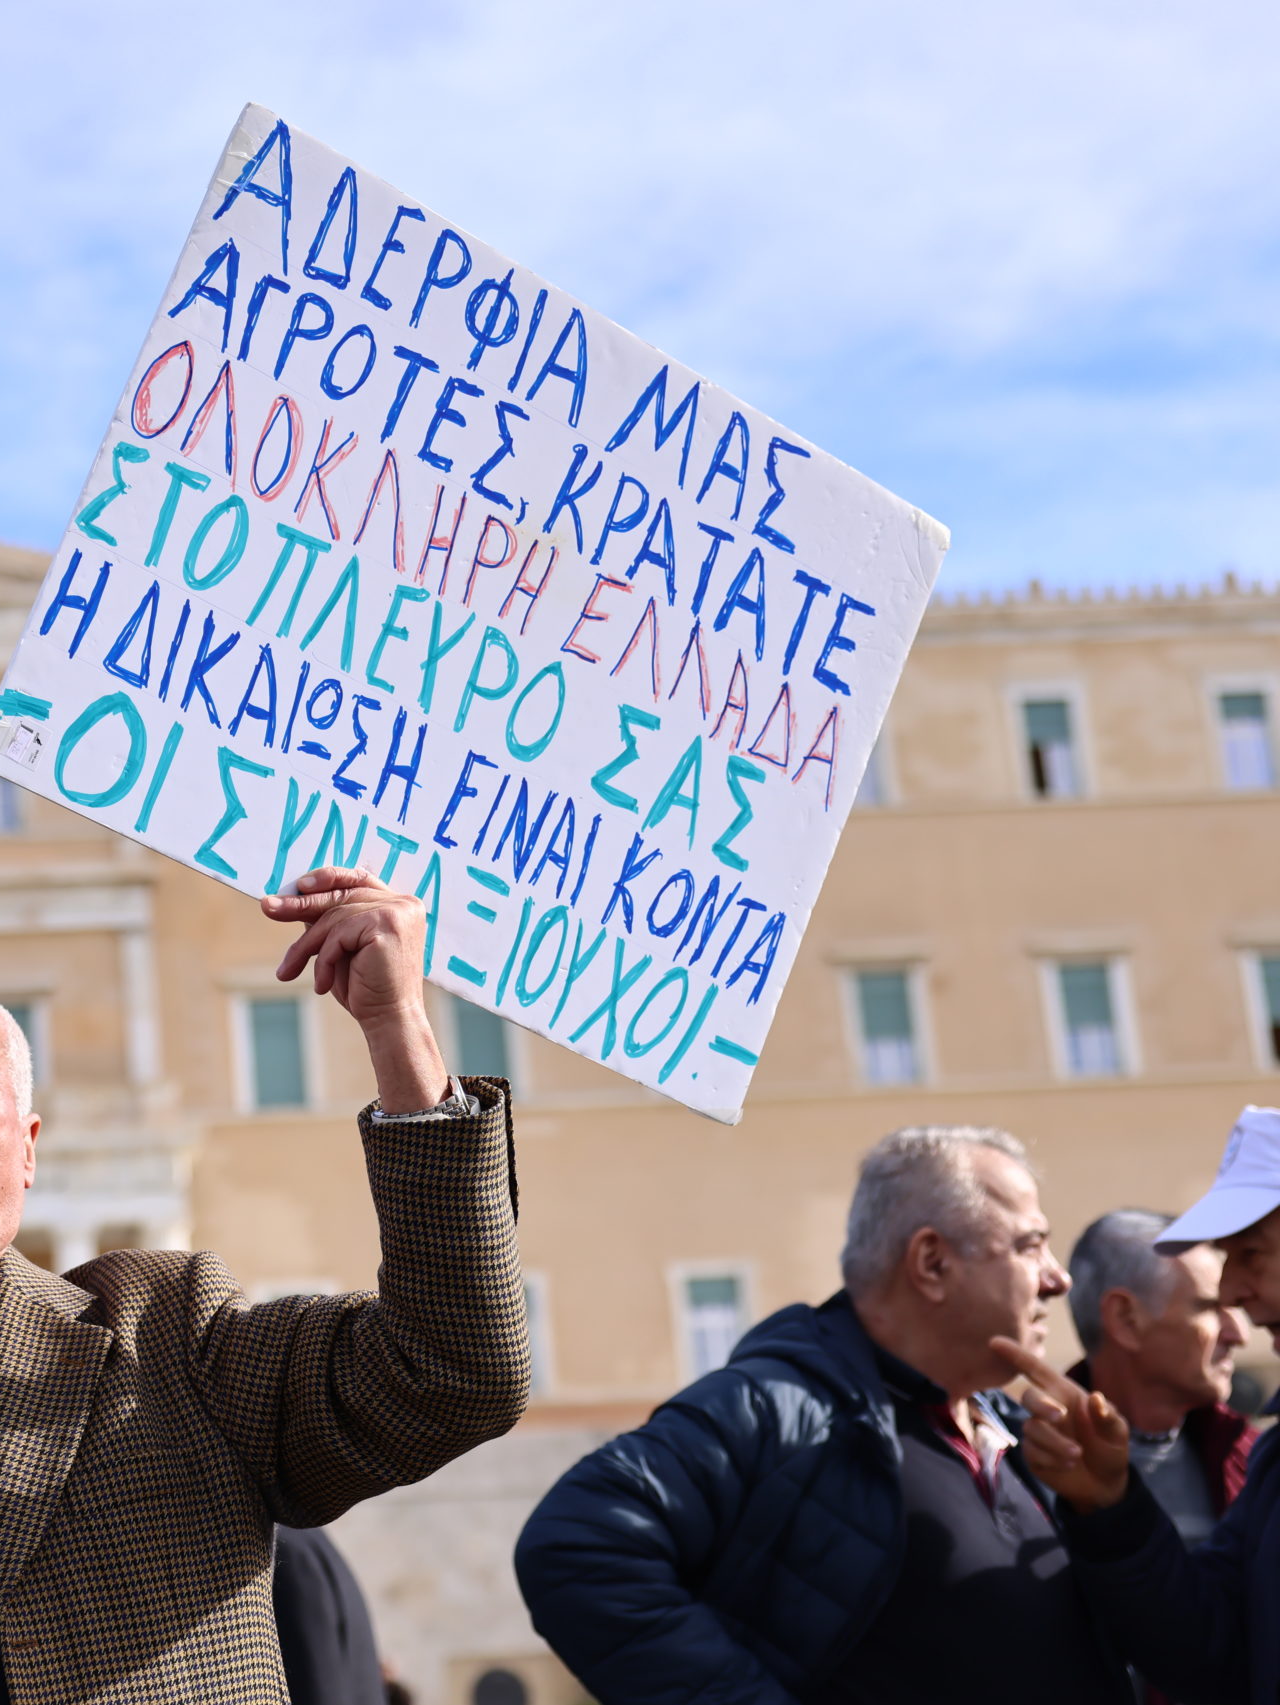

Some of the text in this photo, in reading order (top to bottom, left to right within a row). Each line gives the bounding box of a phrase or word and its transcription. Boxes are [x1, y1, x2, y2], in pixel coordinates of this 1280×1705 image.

[168, 238, 875, 696] ΑΓΡΟΤΕΣ, ΚΡΑΤΑΤΕ
[212, 120, 811, 554] ΑΔΕΡΦΙΑ ΜΑΣ
[39, 549, 113, 659] Η
[435, 751, 602, 908] ΕΙΝΑΙ
[597, 832, 786, 1005] ΚΟΝΤΑ
[74, 443, 766, 872] ΣΤΟ ΠΛΕΥΡΟ ΣΑΣ
[131, 341, 846, 810] ΟΛΟΚΛΗΡΗ ΕΛΛΑΔΑ
